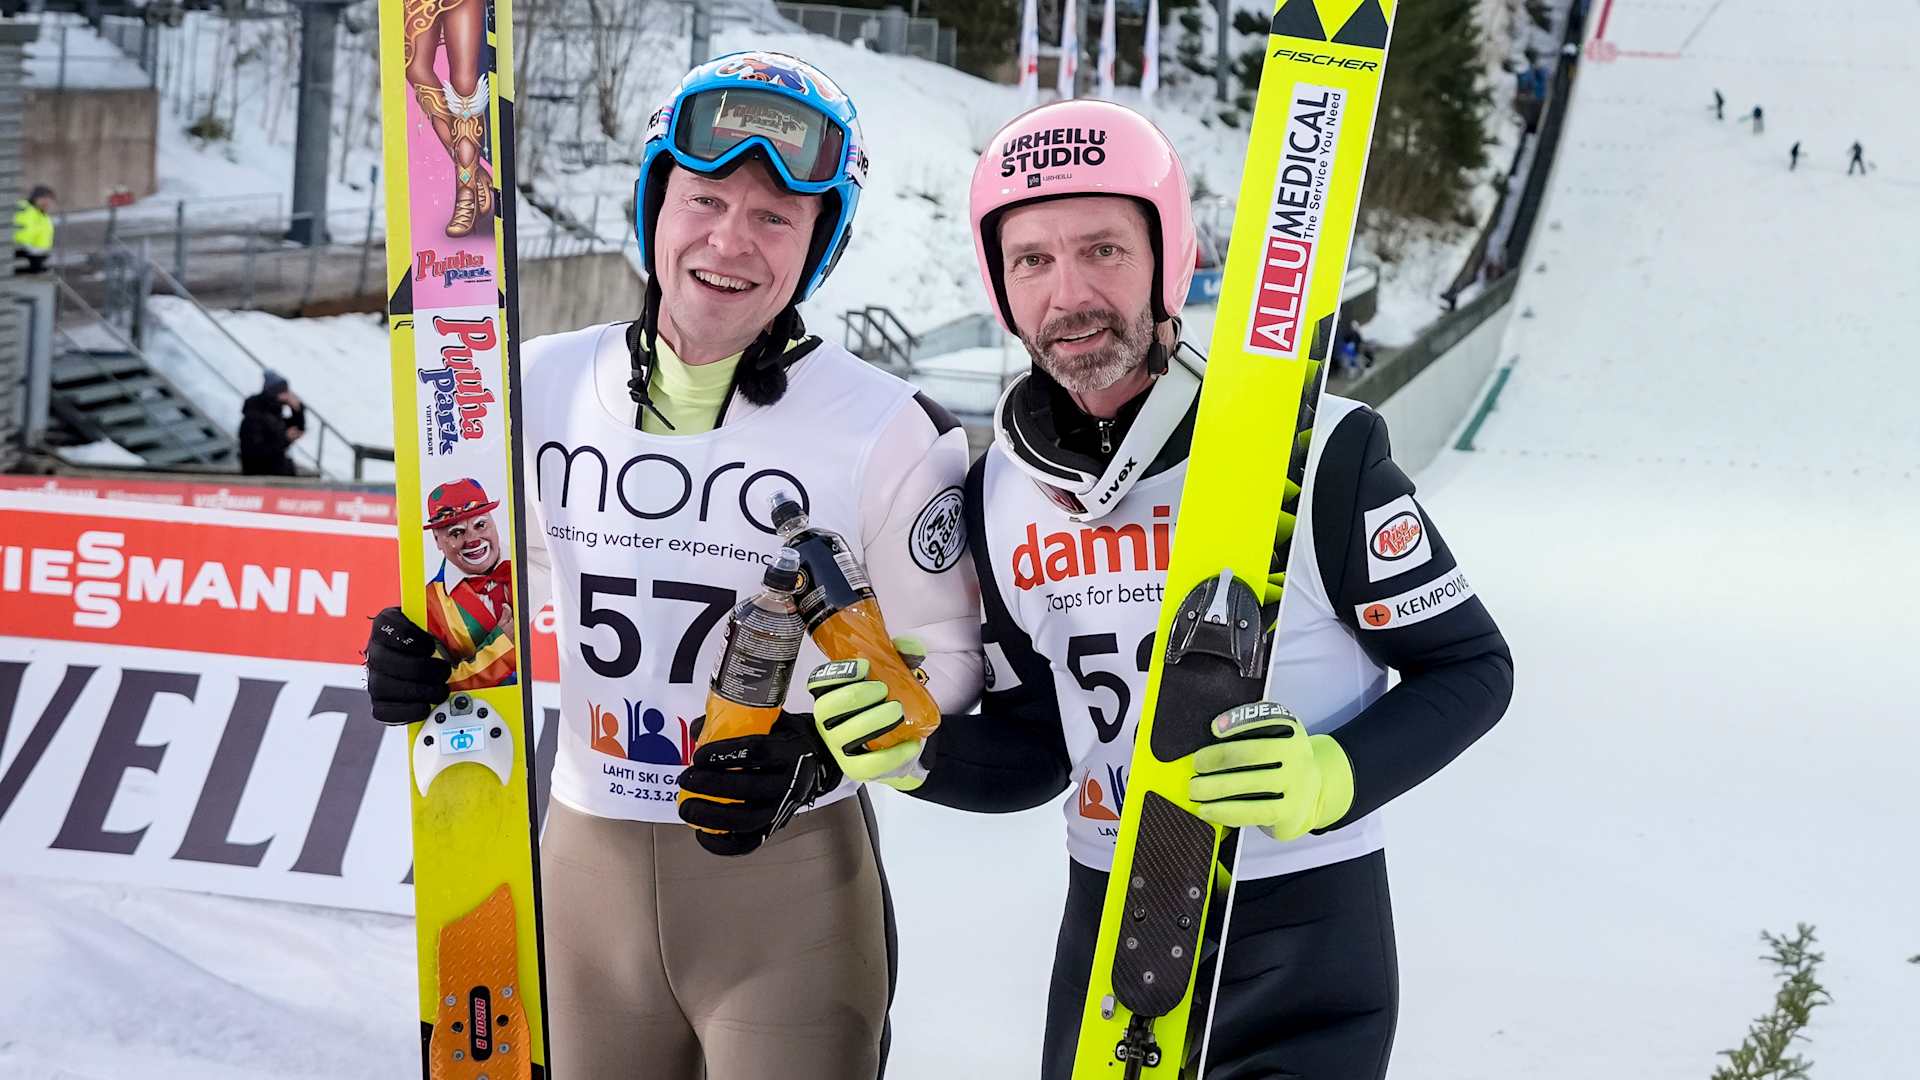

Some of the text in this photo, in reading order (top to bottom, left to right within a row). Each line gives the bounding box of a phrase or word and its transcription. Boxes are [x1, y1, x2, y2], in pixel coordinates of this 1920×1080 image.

[1273, 49, 1378, 73] FISCHER
[1001, 146, 1106, 178] STUDIO
[1003, 128, 1107, 158] URHEILU
[1303, 93, 1341, 239] The Service You Need
[433, 315, 497, 441] Puuha
[1099, 456, 1138, 505] uvex
[545, 519, 775, 567] Lasting water experienc
[1012, 505, 1171, 591] dami
[0, 531, 349, 629] IESSMANN
[1046, 583, 1164, 613] Taps for bett
[579, 572, 737, 684] 57
[1066, 630, 1156, 745] 5
[603, 762, 634, 781] LAHTI
[638, 771, 659, 784] SKI
